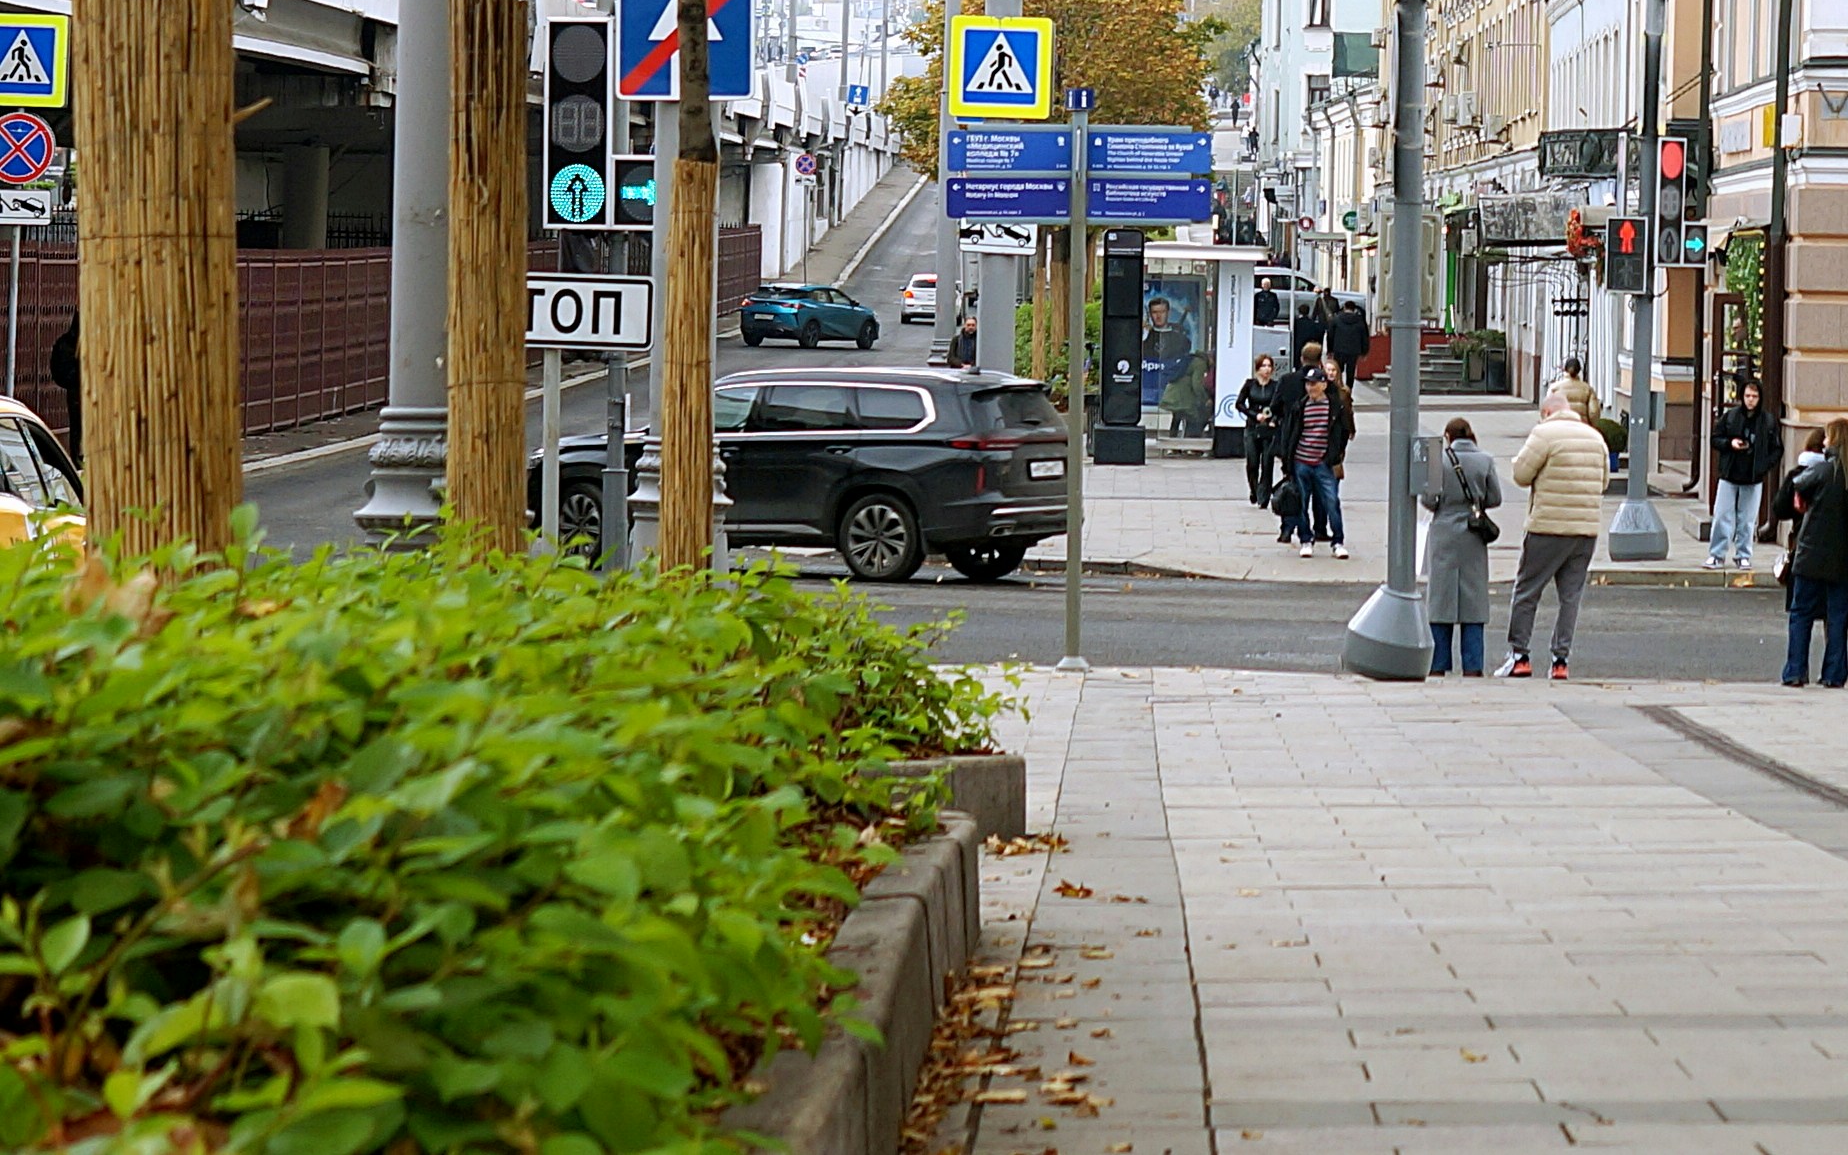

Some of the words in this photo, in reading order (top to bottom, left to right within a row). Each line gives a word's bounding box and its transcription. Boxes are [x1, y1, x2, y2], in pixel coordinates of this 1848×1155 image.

[990, 135, 1021, 143] Москвы
[1025, 182, 1054, 190] Москвы
[525, 287, 623, 336] ТОП
